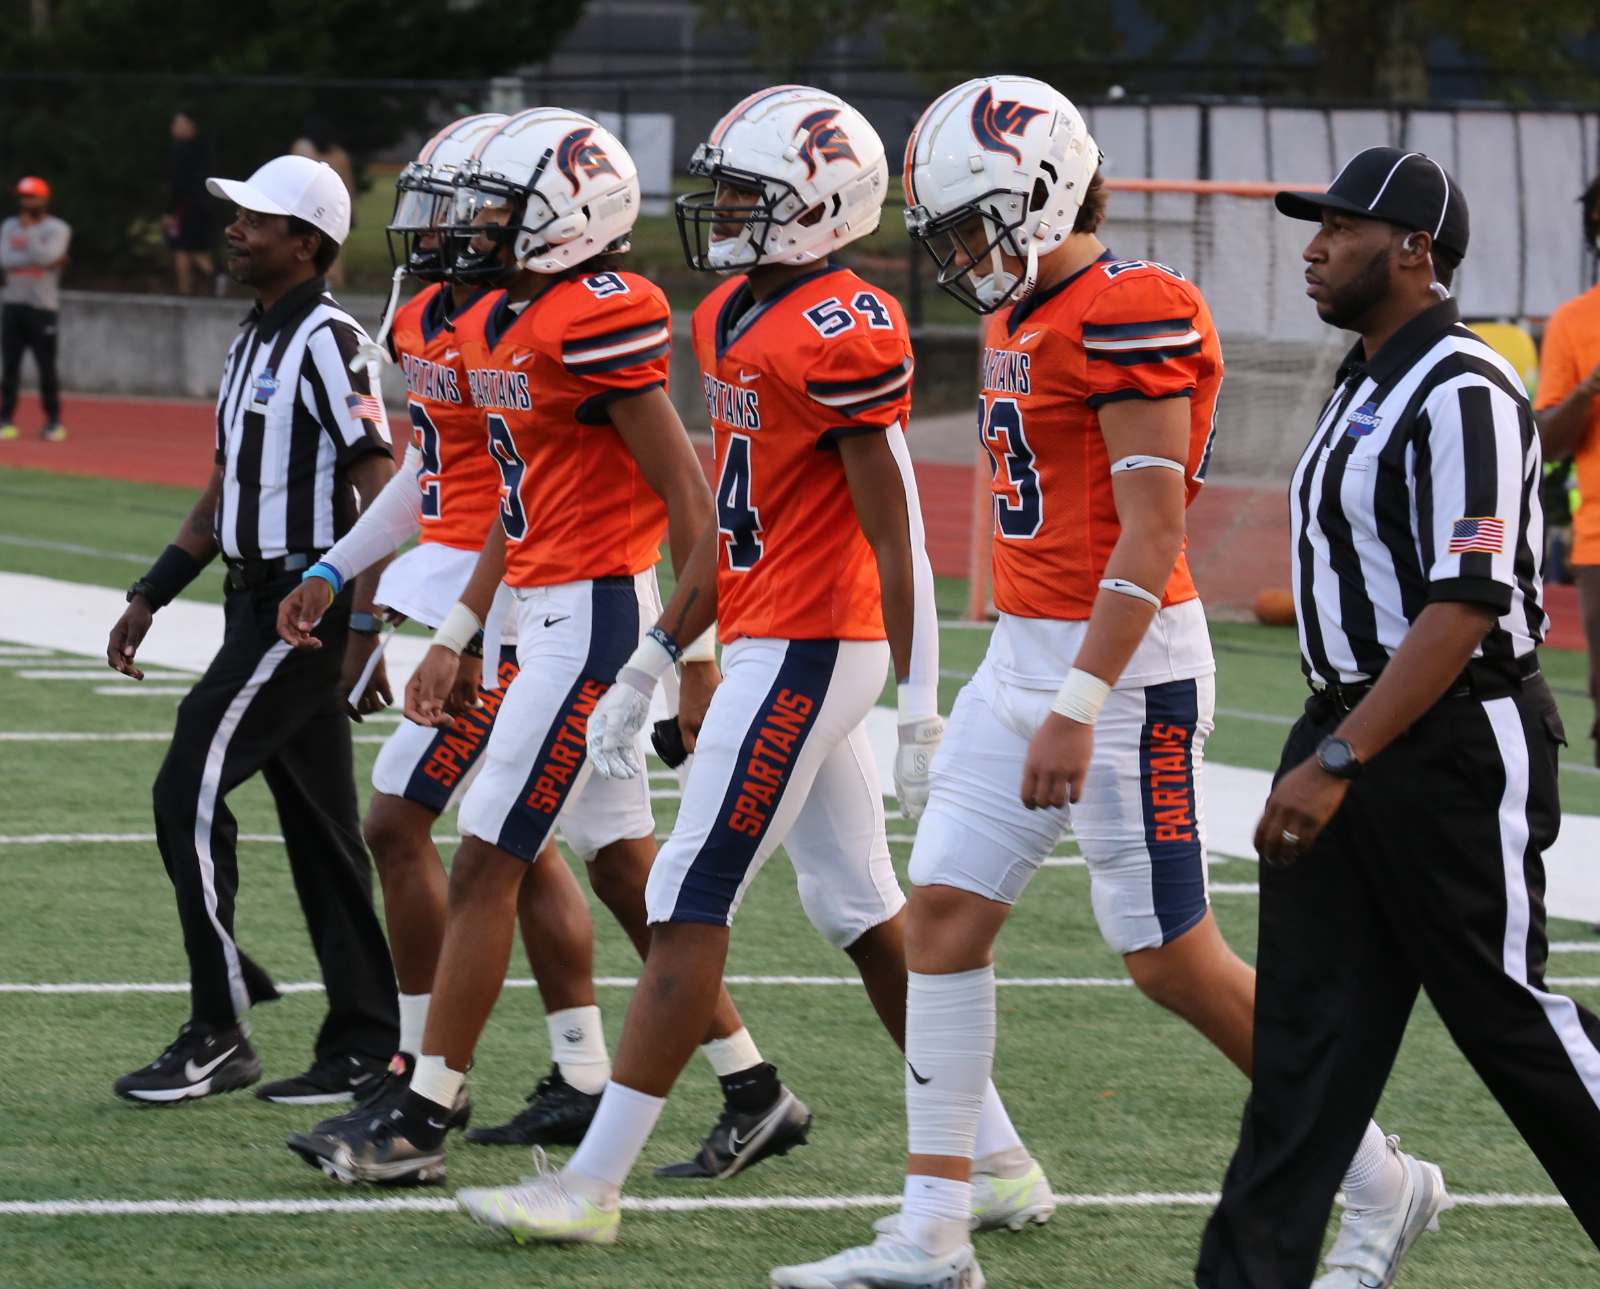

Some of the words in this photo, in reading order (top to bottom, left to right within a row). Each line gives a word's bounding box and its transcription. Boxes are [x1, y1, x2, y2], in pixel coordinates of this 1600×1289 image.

[314, 206, 326, 219] S
[582, 271, 631, 300] 9
[802, 291, 894, 339] 54
[402, 352, 463, 404] ARTANS
[1347, 411, 1383, 428] GHSA
[407, 399, 441, 520] 2
[487, 413, 528, 543] 9
[711, 428, 764, 572] 4
[728, 688, 814, 837] SPARTANS
